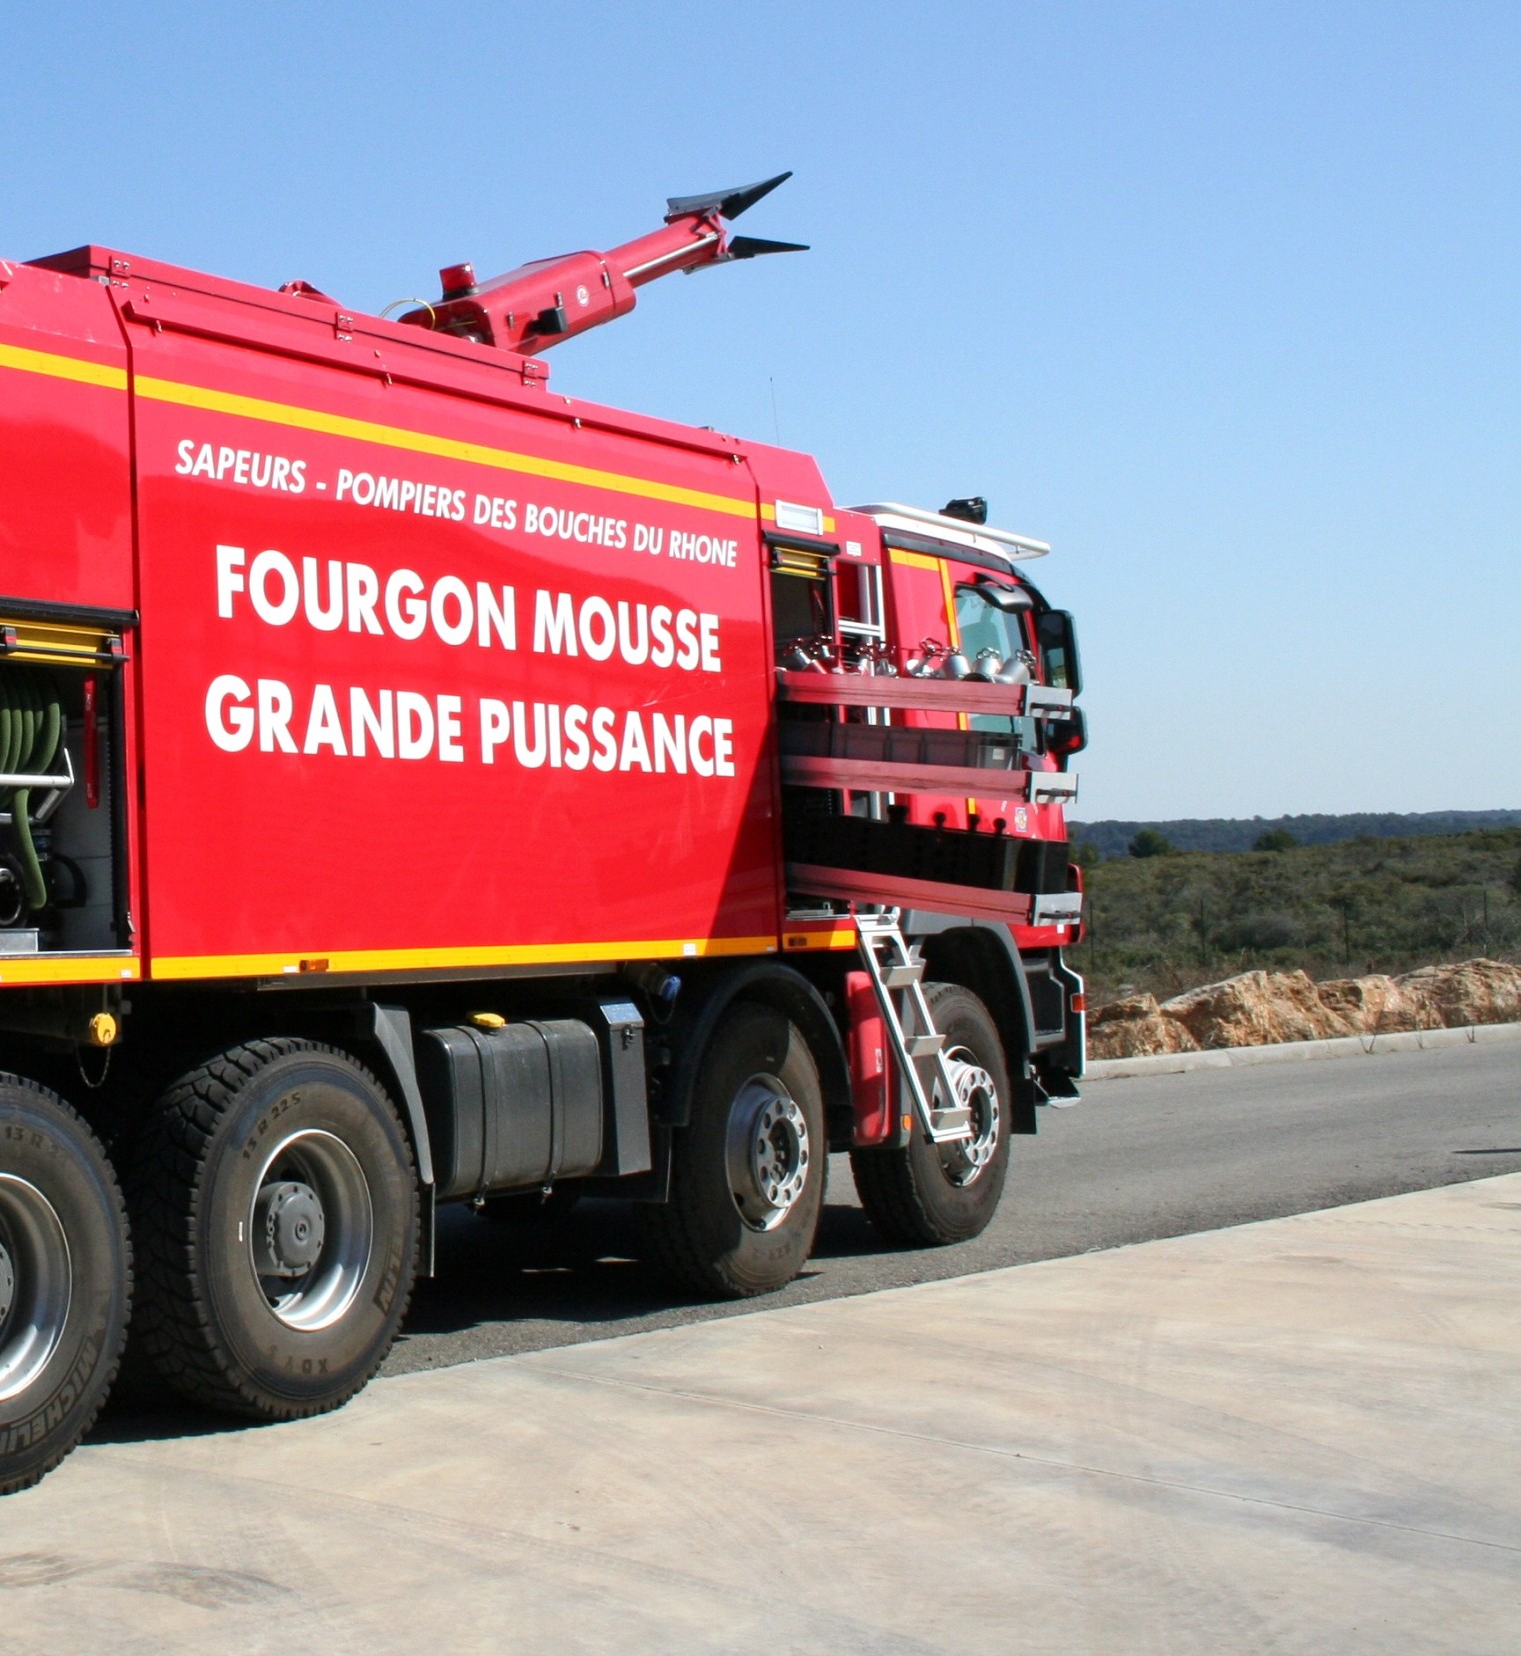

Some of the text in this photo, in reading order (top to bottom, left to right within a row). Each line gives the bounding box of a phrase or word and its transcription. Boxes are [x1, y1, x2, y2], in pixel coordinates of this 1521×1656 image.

[175, 439, 307, 493] SAPEURS
[336, 468, 466, 521] POMPIERS
[473, 494, 517, 530] DES
[524, 503, 627, 549] BOUCHES
[633, 523, 663, 555] DU
[669, 530, 738, 567] RHONE
[216, 544, 721, 672] FOURGON MOUSSE
[205, 674, 735, 777] GRANDE PUISSANCE
